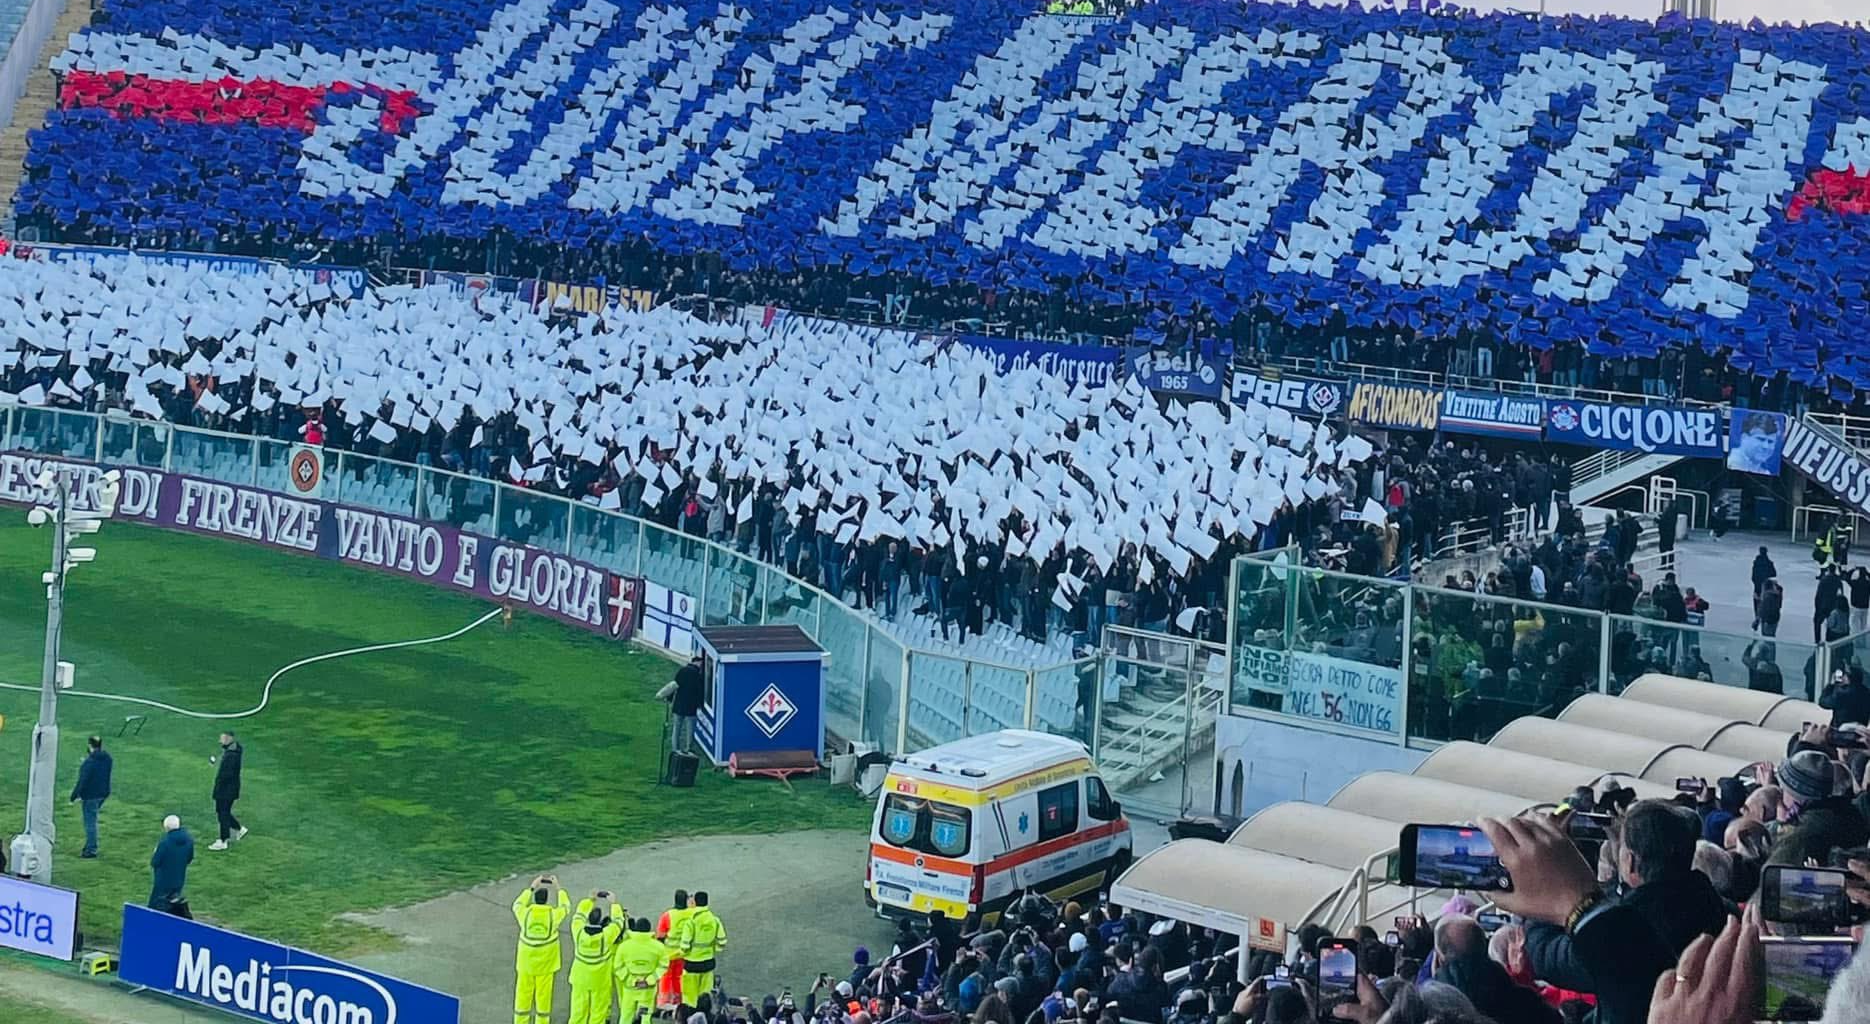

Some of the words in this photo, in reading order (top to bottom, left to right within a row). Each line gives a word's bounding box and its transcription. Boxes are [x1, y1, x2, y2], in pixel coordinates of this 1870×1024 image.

[546, 281, 661, 314] MARSM
[1161, 376, 1189, 390] 1965
[1232, 372, 1306, 408] PAG
[1349, 383, 1443, 430] AFICIONADOS
[1581, 404, 1717, 452] CICLONE
[0, 454, 108, 512] ESSER
[120, 469, 163, 519] DI
[175, 478, 321, 551] FIRENZE
[334, 508, 444, 576] VANTO
[453, 534, 478, 588] E
[489, 545, 603, 626] GLORIA
[1328, 665, 1361, 689] DETTO
[175, 942, 373, 1024] Mediacom
